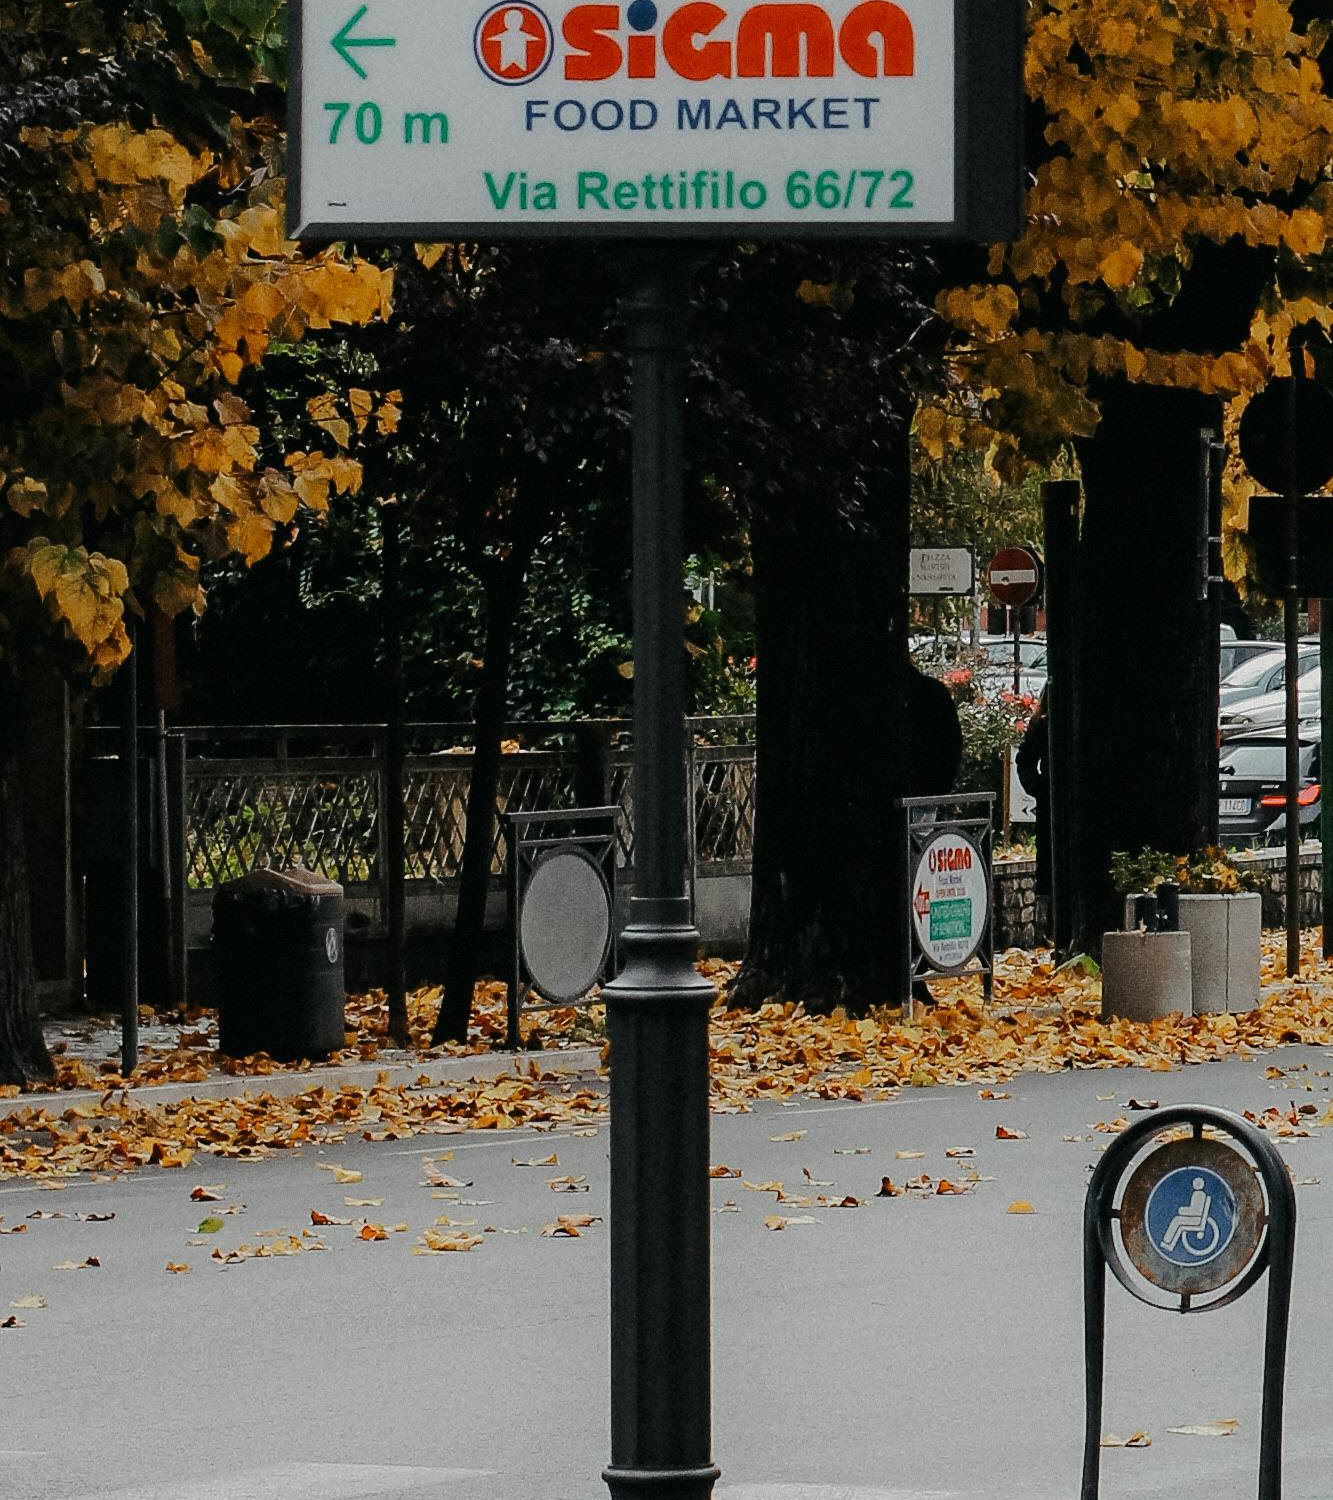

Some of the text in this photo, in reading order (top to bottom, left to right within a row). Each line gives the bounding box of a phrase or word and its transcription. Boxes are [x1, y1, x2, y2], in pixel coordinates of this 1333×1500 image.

[323, 102, 449, 145] 70 m
[524, 97, 881, 132] FOOD MARKET
[483, 170, 915, 212] Via Rettifilo 66/72
